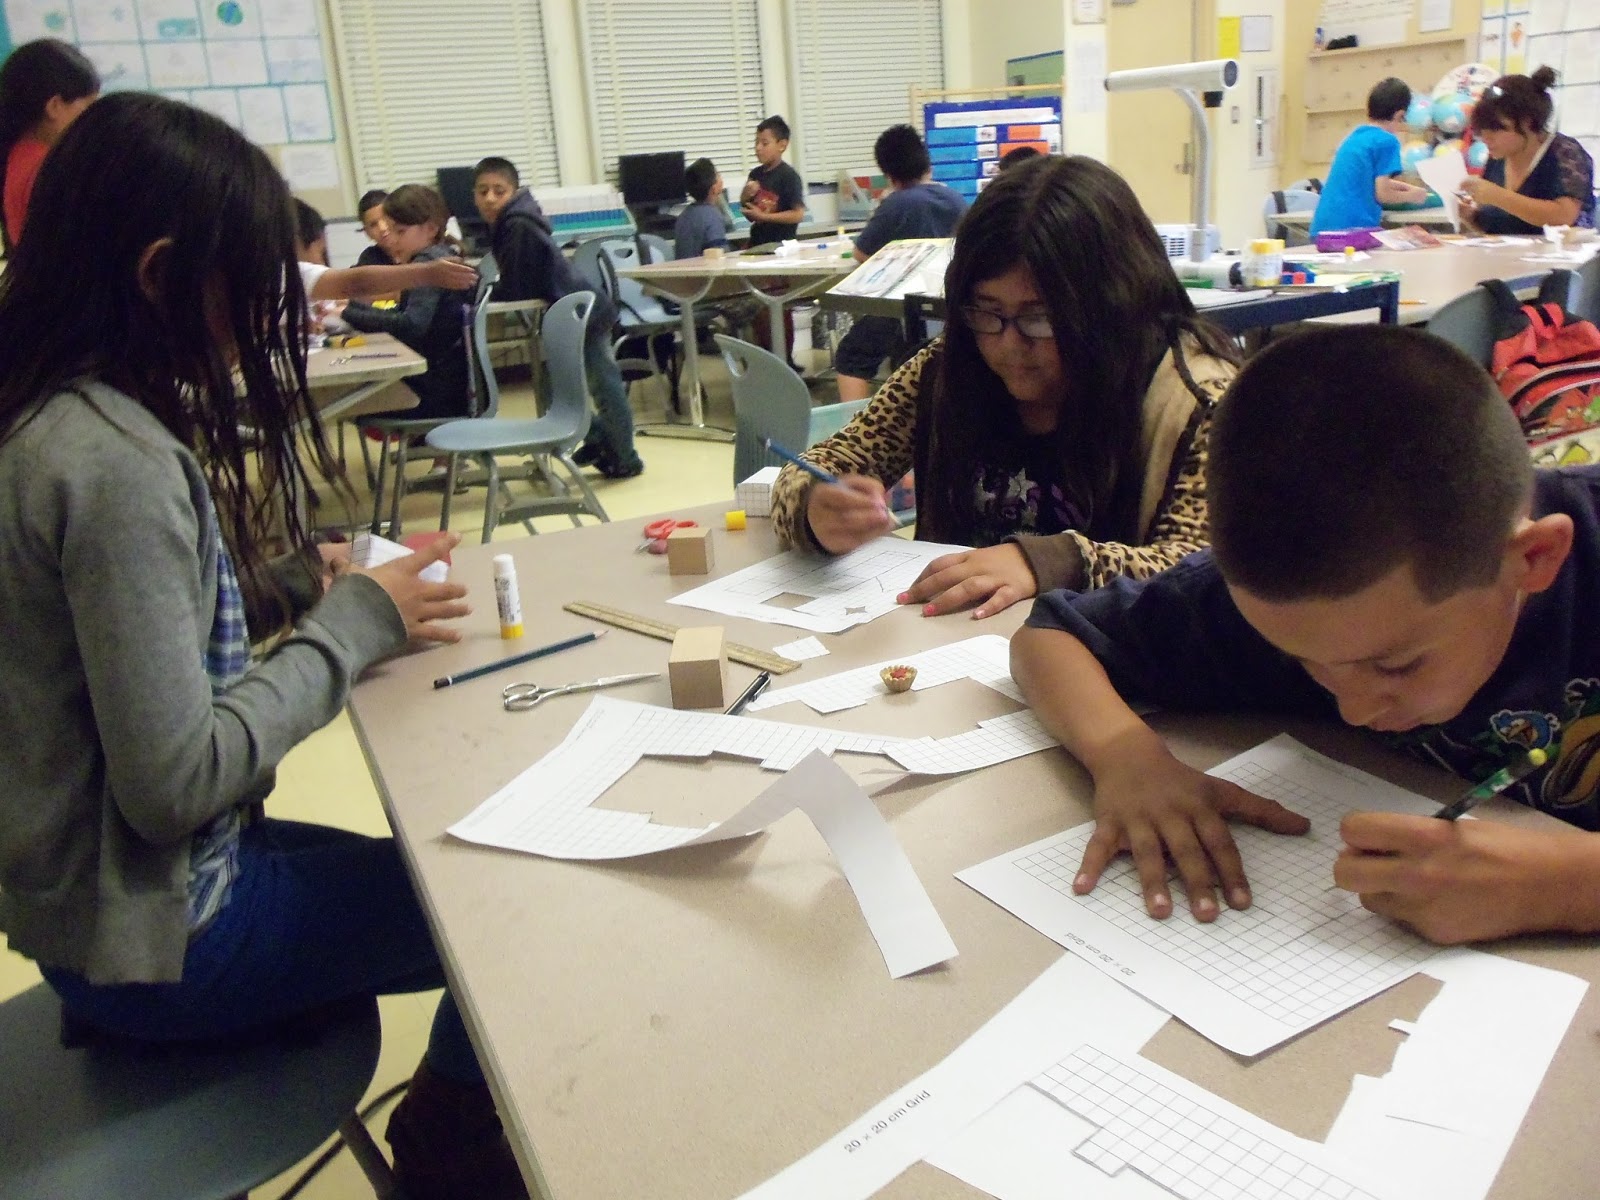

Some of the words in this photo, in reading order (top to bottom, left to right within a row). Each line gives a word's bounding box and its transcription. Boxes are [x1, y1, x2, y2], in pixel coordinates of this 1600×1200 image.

[1064, 932, 1086, 946] Grid
[1085, 944, 1101, 954] cm
[843, 1139, 861, 1153] 20
[871, 1120, 888, 1134] 20
[888, 1107, 907, 1122] cm
[905, 1089, 931, 1109] Grid
